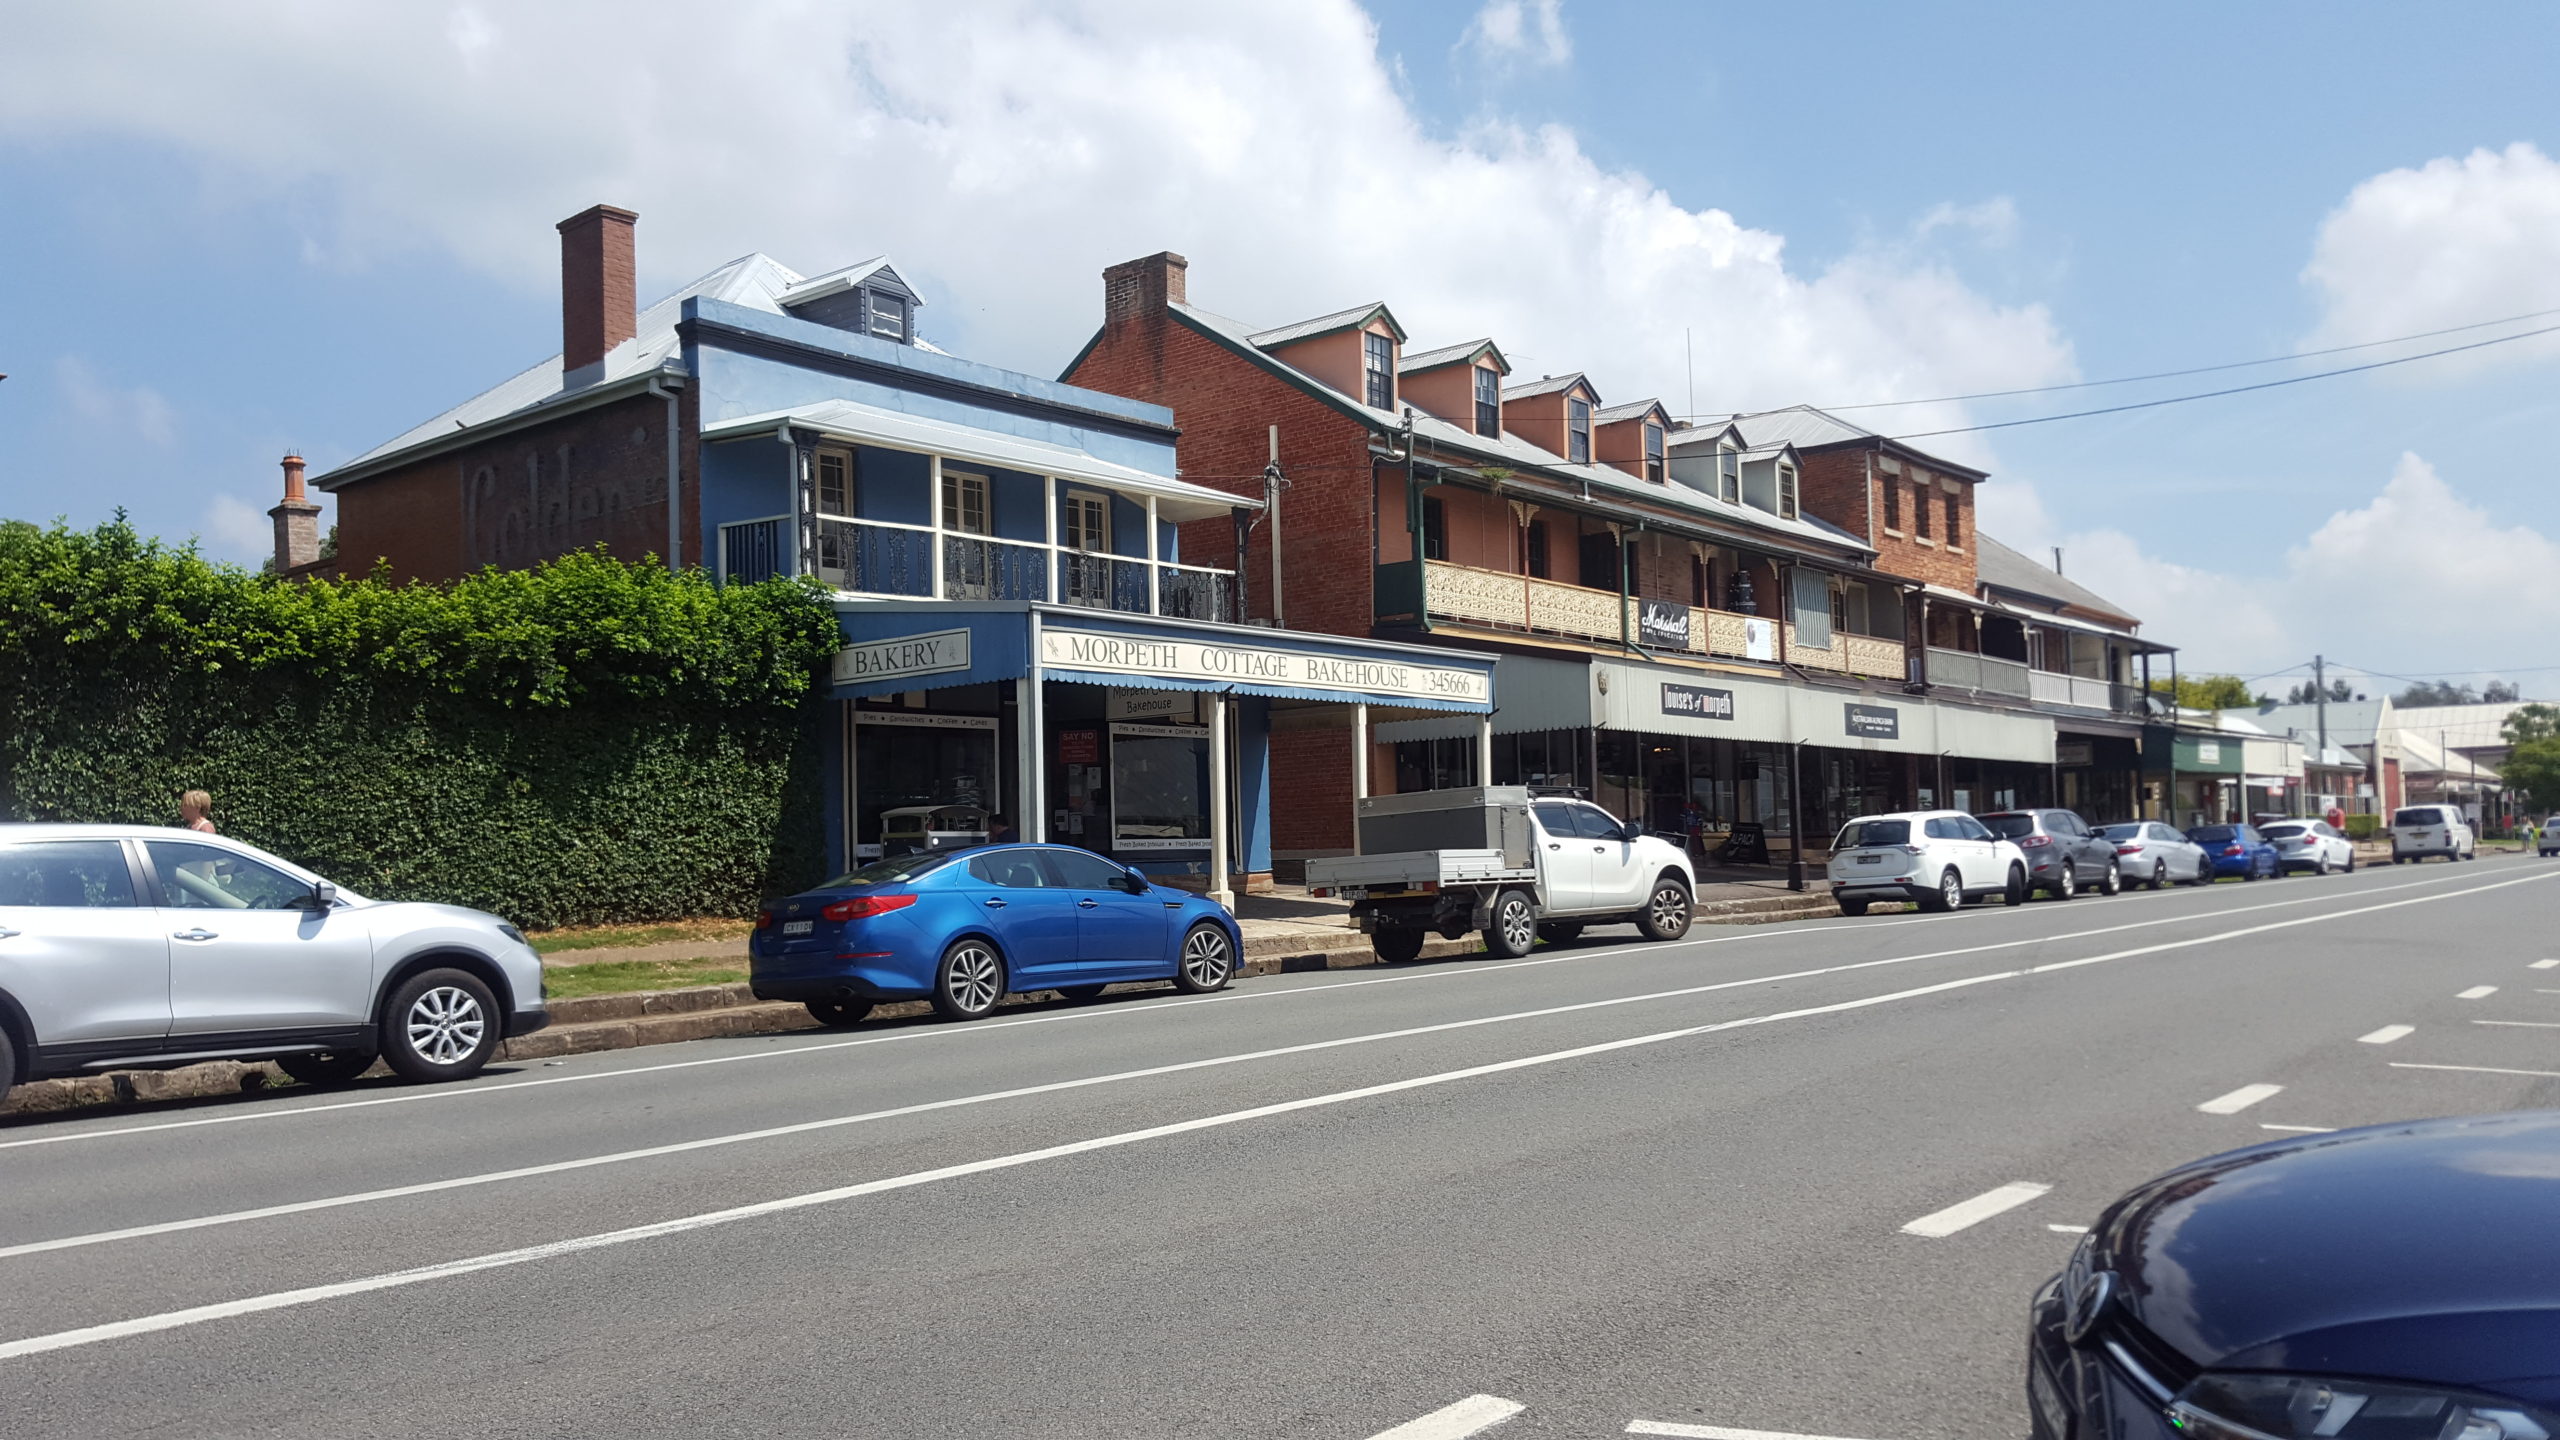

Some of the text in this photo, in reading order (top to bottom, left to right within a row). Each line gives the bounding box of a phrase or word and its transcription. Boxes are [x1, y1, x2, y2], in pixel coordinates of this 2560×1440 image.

[854, 640, 941, 674] BAKERY
[1070, 636, 1178, 668] MORPETH
[1200, 648, 1289, 678] COTTAGE
[1306, 658, 1409, 689] BAKEHOUSE
[1428, 671, 1471, 694] 345666
[1126, 699, 1172, 714] Bakehouse
